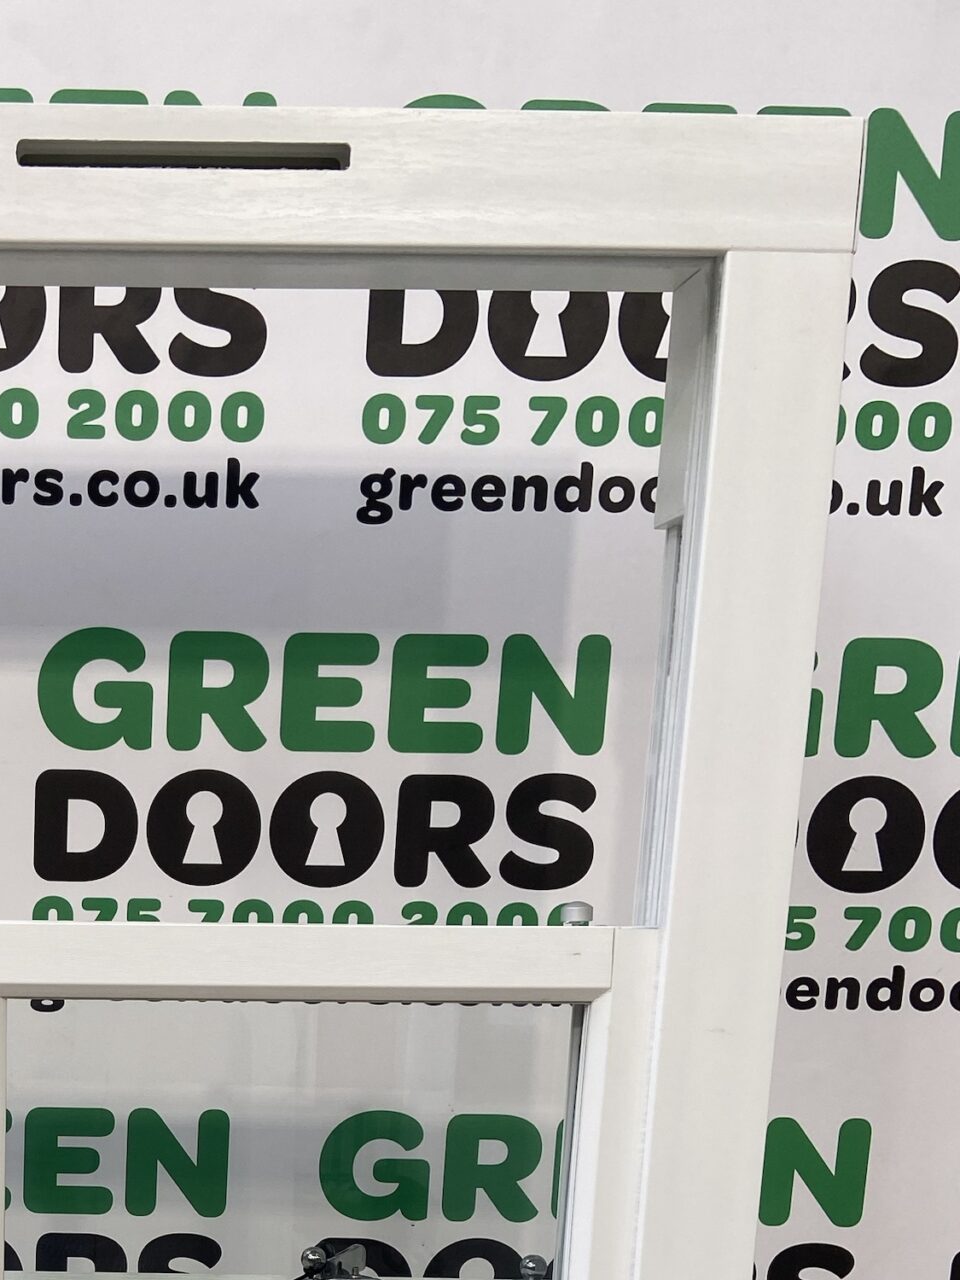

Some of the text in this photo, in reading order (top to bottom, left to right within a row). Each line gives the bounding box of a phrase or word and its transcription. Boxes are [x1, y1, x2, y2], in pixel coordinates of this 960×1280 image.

[66, 388, 265, 442] 2000
[362, 393, 500, 445] 075
[528, 395, 663, 447] 700
[37, 627, 612, 756] GREEN
[33, 769, 597, 891] DOORS
